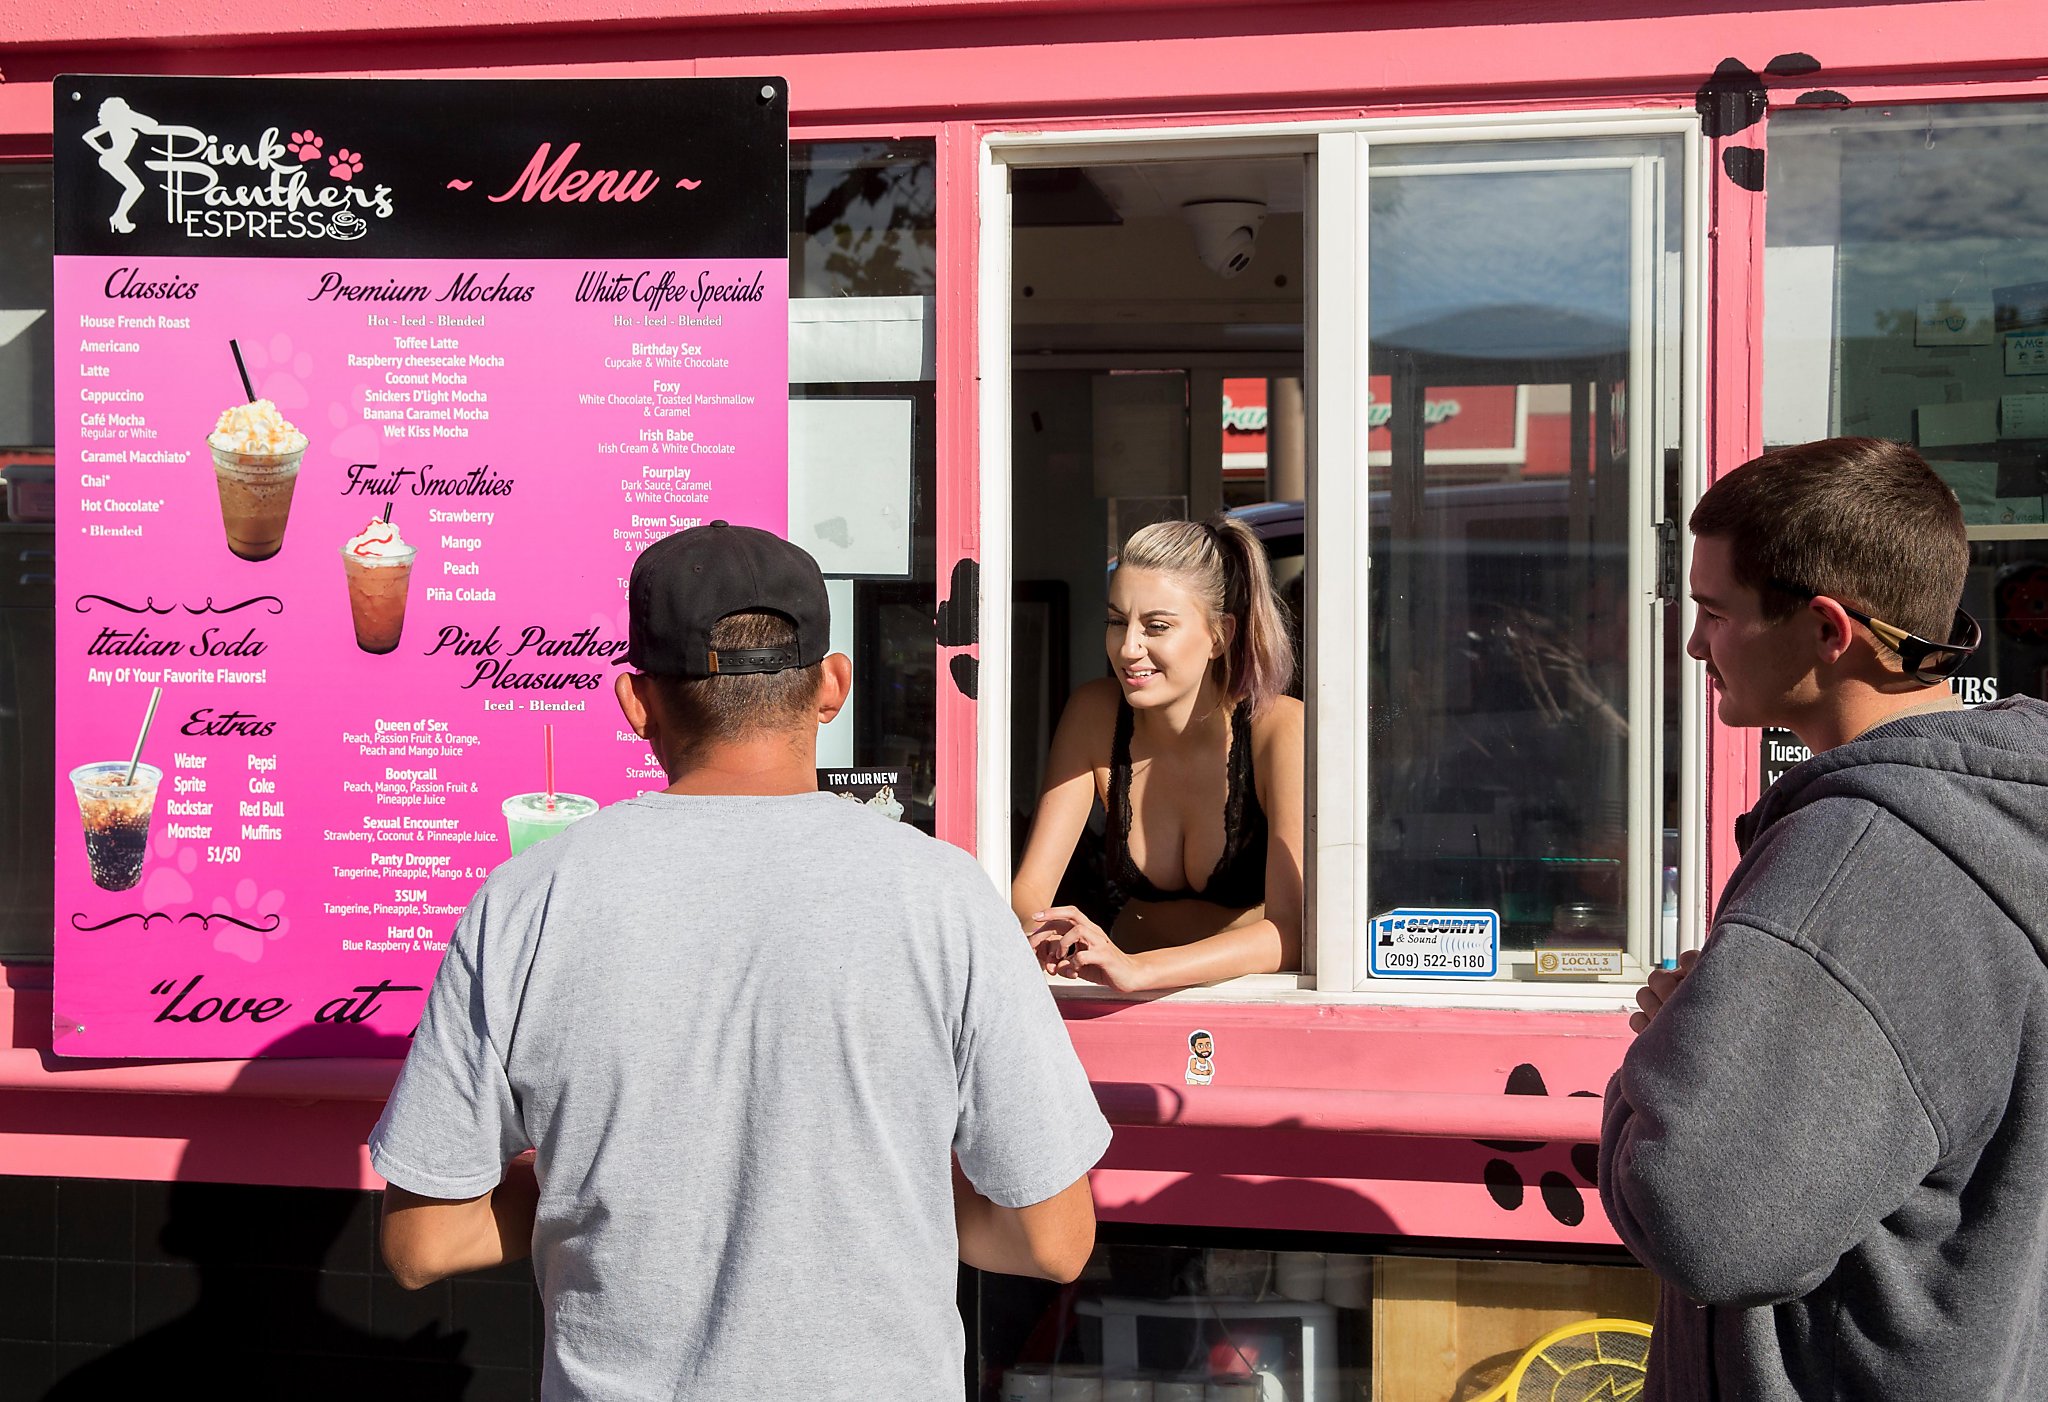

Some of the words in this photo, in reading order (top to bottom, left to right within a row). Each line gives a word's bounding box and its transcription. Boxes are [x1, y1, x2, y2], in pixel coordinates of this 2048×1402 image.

[487, 141, 661, 203] Menu
[144, 160, 394, 222] Panthers
[104, 267, 200, 300] Classics
[307, 271, 432, 302] Premium
[434, 272, 536, 302] Mochas
[574, 270, 634, 303] White
[632, 270, 688, 312] Coffee
[689, 270, 765, 313] Specials
[80, 314, 116, 328] House
[117, 314, 156, 329] French
[158, 315, 191, 329] Roast
[367, 314, 389, 326] Hot
[401, 314, 426, 326] Iced
[437, 314, 485, 327] Blended
[614, 315, 633, 326] Hot
[644, 315, 667, 326] Iced
[678, 314, 722, 326] Blended
[79, 339, 140, 353] Americano
[393, 336, 428, 349] Toffee
[430, 336, 459, 349] Latte
[632, 342, 679, 357] Birthday
[681, 342, 702, 356] Sex
[347, 353, 403, 370] Raspberry
[404, 354, 467, 367] cheesecake
[468, 354, 505, 367] Mocha
[604, 356, 643, 370] Cupcake
[655, 355, 682, 368] White
[683, 356, 729, 368] Chocolate
[80, 363, 110, 377] Latte
[385, 371, 430, 385] Coconut
[431, 371, 468, 385] Mocha
[653, 379, 681, 394] Foxy
[80, 388, 145, 405] Cappuccino
[364, 389, 411, 402] Snickers
[412, 389, 450, 405] D'light
[451, 389, 488, 403] Mocha
[578, 393, 606, 405] White
[607, 393, 655, 406] Chocolate,
[656, 393, 693, 405] Toasted
[694, 393, 755, 405] Marshmallow
[80, 412, 106, 426] Café
[108, 413, 146, 426] Mocha
[363, 407, 404, 420] Banana
[406, 407, 452, 420] Caramel
[453, 407, 489, 420] Mocha
[653, 406, 691, 417] Caramel
[80, 426, 117, 441] Regular
[129, 427, 158, 439] White
[383, 425, 406, 438] Wet
[407, 425, 431, 438] Kiss
[432, 425, 469, 438] Mocha
[639, 428, 664, 442] Irish
[666, 428, 694, 442] Babe
[598, 442, 618, 454] Irish
[619, 442, 649, 454] Cream
[661, 443, 689, 454] White
[690, 442, 736, 454] Chocolate
[80, 449, 128, 463] Caramel
[340, 463, 417, 496] Fruit
[411, 464, 515, 496] Smoothies
[642, 465, 691, 481] Fourplay
[621, 479, 643, 491] Dark
[644, 478, 673, 492] Sauce,
[675, 478, 713, 491] Caramel
[635, 491, 662, 503] White
[663, 491, 709, 503] Chocolate
[81, 499, 102, 512] Hot
[429, 508, 495, 526] Strawberry
[631, 515, 665, 527] Brown
[669, 515, 702, 530] Sugar
[90, 524, 143, 537] Blended
[441, 535, 482, 552] Mango
[443, 561, 480, 575] Peach
[426, 587, 453, 601] Piña
[455, 587, 496, 602] Colada
[87, 626, 185, 657] Italian
[189, 627, 268, 657] Soda
[423, 625, 503, 656] Pink
[88, 667, 113, 687] Any
[114, 667, 131, 683] Of
[132, 668, 162, 683] Your
[163, 668, 215, 683] Favorite
[216, 668, 267, 684] Flavors!
[460, 658, 603, 690] Pleasures
[484, 699, 514, 711] Iced
[529, 699, 586, 711] Blended
[180, 708, 277, 737] Extras
[374, 718, 411, 733] Queen
[427, 719, 448, 732] Sex
[343, 732, 373, 747] Peach,
[374, 732, 409, 744] Passion
[410, 732, 432, 744] Fruit
[445, 732, 481, 747] Orange,
[359, 744, 387, 756] Peach
[408, 745, 439, 759] Mango
[440, 745, 464, 757] Juice
[174, 752, 207, 769] Water
[247, 754, 277, 774] Pepsi
[384, 767, 438, 784] Bootycall
[827, 773, 849, 785] TRY
[850, 773, 873, 785] OUR
[873, 772, 898, 784] NEW
[174, 775, 207, 796] Sprite
[248, 777, 275, 794] Coke
[343, 781, 374, 793] Peach,
[375, 781, 409, 795] Mango,
[409, 781, 445, 793] Passion
[446, 781, 468, 793] Fruit
[167, 799, 213, 815] Rockstar
[376, 792, 422, 807] Pineapple
[423, 794, 446, 805] Juice
[239, 801, 260, 817] Red
[262, 801, 285, 817] Bull
[167, 822, 213, 839] Monster
[363, 816, 401, 829] Sexual
[403, 816, 460, 830] Encounter
[241, 824, 282, 840] Muffins
[323, 829, 375, 843] Strawberry,
[376, 829, 414, 841] Coconut
[427, 830, 472, 844] Pinneaple
[207, 846, 241, 864] 51/50
[371, 852, 404, 868] Panty
[405, 853, 451, 868] Dropper
[332, 866, 381, 880] Tangerine,
[382, 865, 430, 880] Pineapple,
[431, 867, 463, 880] Mango
[395, 889, 427, 902] 3SUM
[323, 902, 372, 917] Tangerine,
[373, 903, 421, 917] Pineapple,
[387, 926, 415, 939] Hard
[416, 926, 433, 939] On
[1406, 918, 1490, 934] SECURITY
[342, 939, 364, 951] Blue
[365, 939, 411, 953] Raspberry
[1407, 934, 1438, 944] Sound
[1384, 952, 1419, 968] (209)
[1423, 954, 1485, 968] 522-6180
[1561, 957, 1600, 966] LOCAL
[1602, 957, 1609, 966] 3
[313, 979, 424, 1024] at
